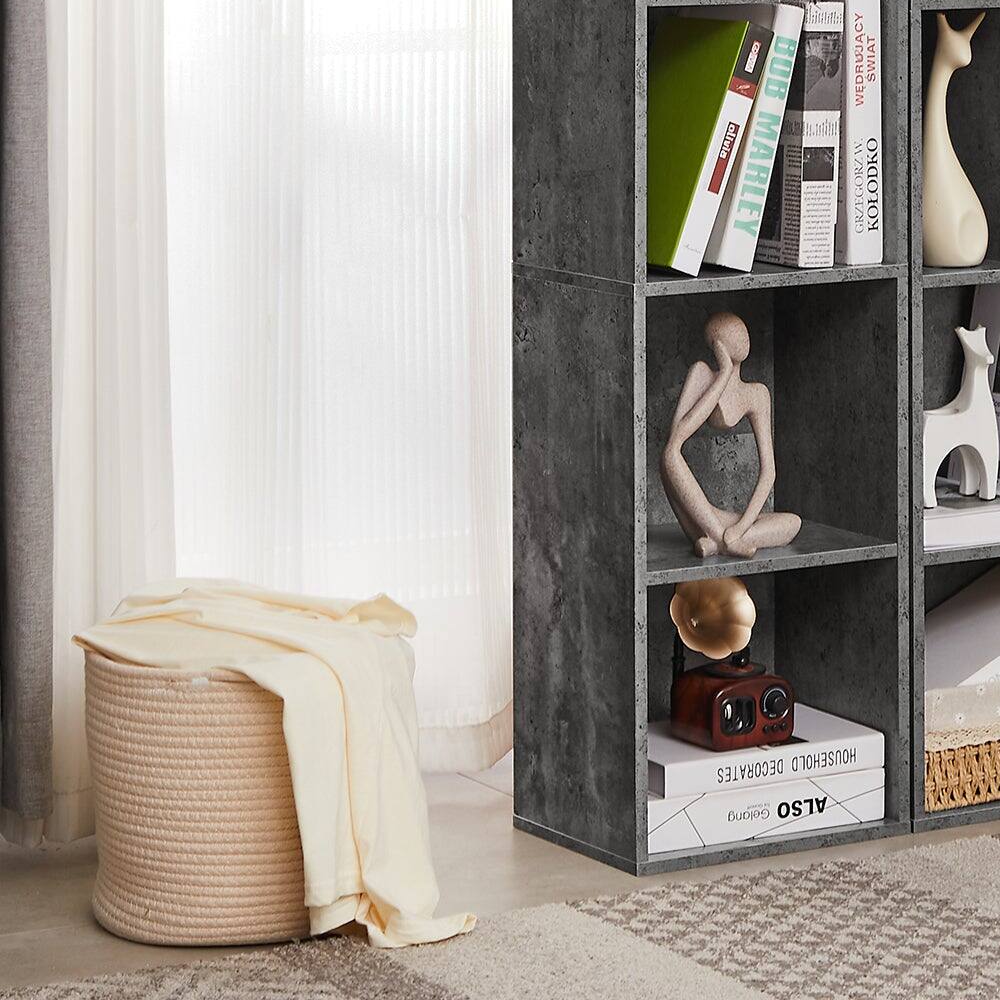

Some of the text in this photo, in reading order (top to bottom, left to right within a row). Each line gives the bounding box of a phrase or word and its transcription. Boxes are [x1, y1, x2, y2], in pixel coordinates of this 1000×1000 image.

[764, 35, 797, 101] BOB
[866, 36, 876, 82] ŚWIAT
[719, 124, 737, 159] olivia
[733, 111, 781, 238] MARLEY
[855, 159, 864, 234] GRZEGORZ
[867, 137, 879, 232] KOŁODKO
[717, 747, 857, 784] HOUSEHOLD DECORATES
[727, 808, 770, 822] Gelang
[777, 796, 828, 819] ALSO
